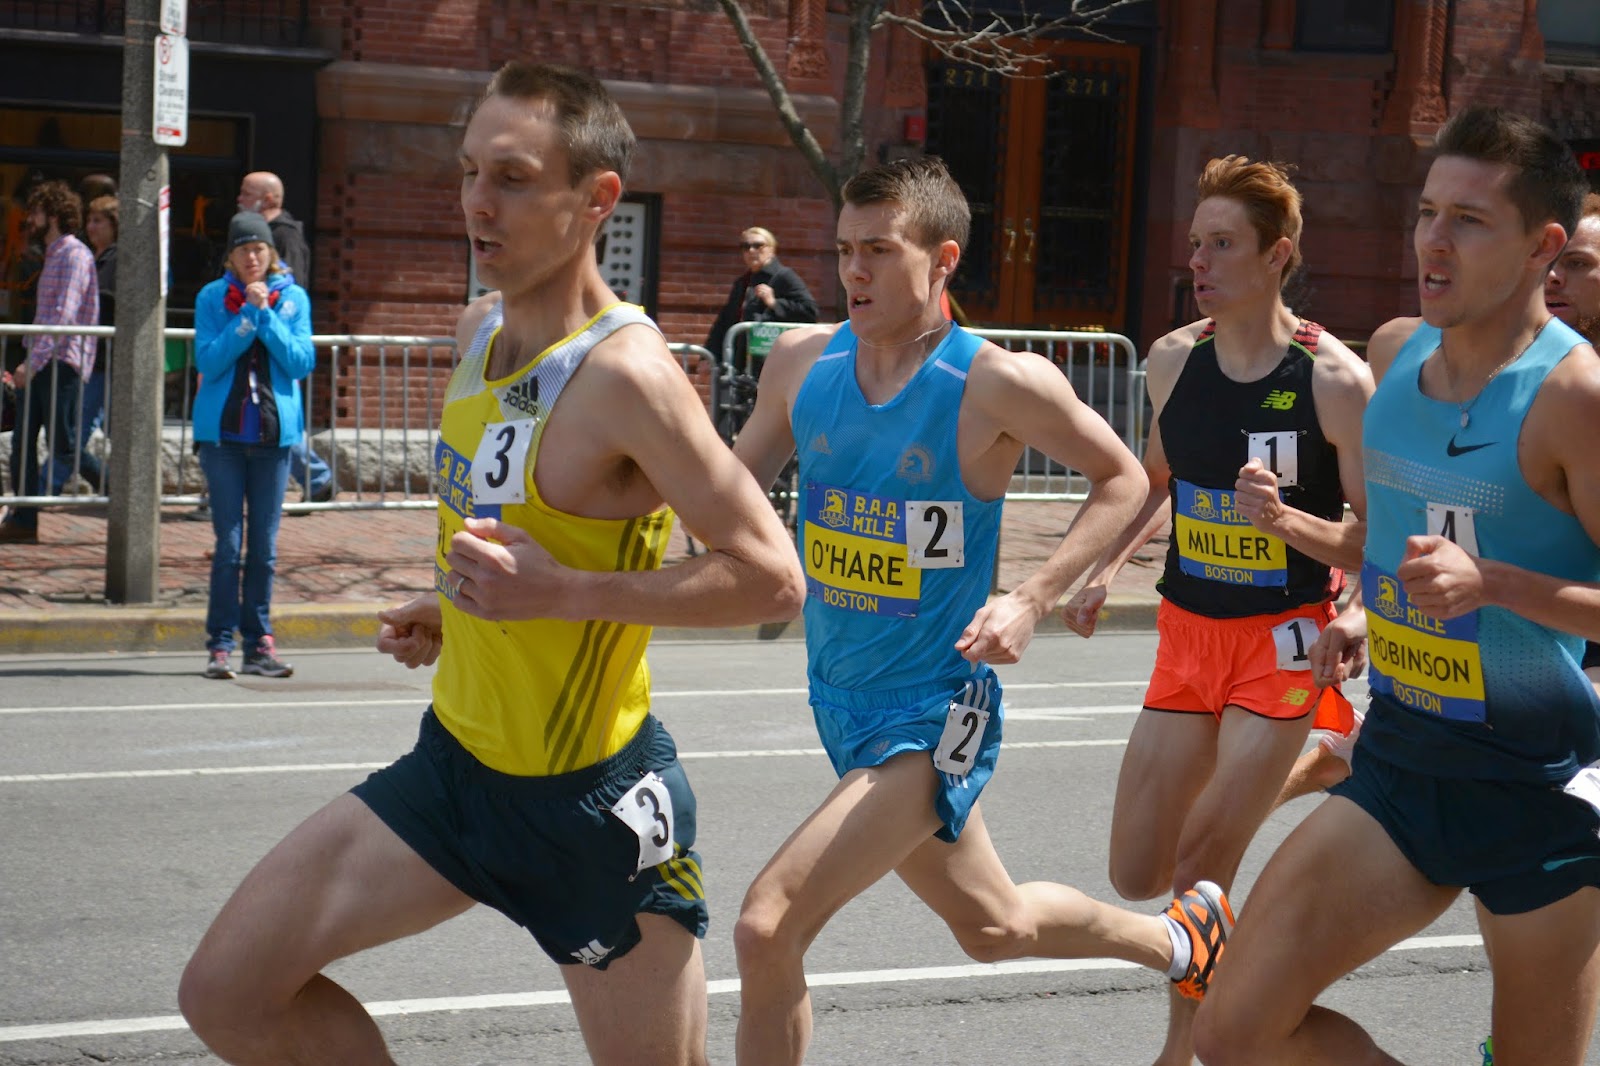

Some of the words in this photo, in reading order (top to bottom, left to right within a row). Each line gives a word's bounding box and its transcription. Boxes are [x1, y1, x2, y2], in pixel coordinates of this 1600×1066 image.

[503, 392, 538, 415] adidas
[485, 425, 516, 488] 3
[1265, 436, 1282, 478] 1
[451, 484, 476, 517] MILE
[854, 495, 900, 519] B.A.A.
[1221, 509, 1249, 523] MIL
[852, 515, 896, 538] MILE
[923, 505, 948, 558] 2
[1188, 528, 1272, 561] MILLER
[812, 539, 904, 586] O'HARE
[1204, 565, 1253, 584] BOSTON
[823, 587, 878, 613] BOSTON
[1407, 606, 1446, 634] MILE
[1288, 621, 1308, 661] 1
[1371, 629, 1470, 684] ROBINSON
[1392, 679, 1442, 714] BOSTON
[949, 711, 978, 763] 2
[635, 787, 669, 848] 3
